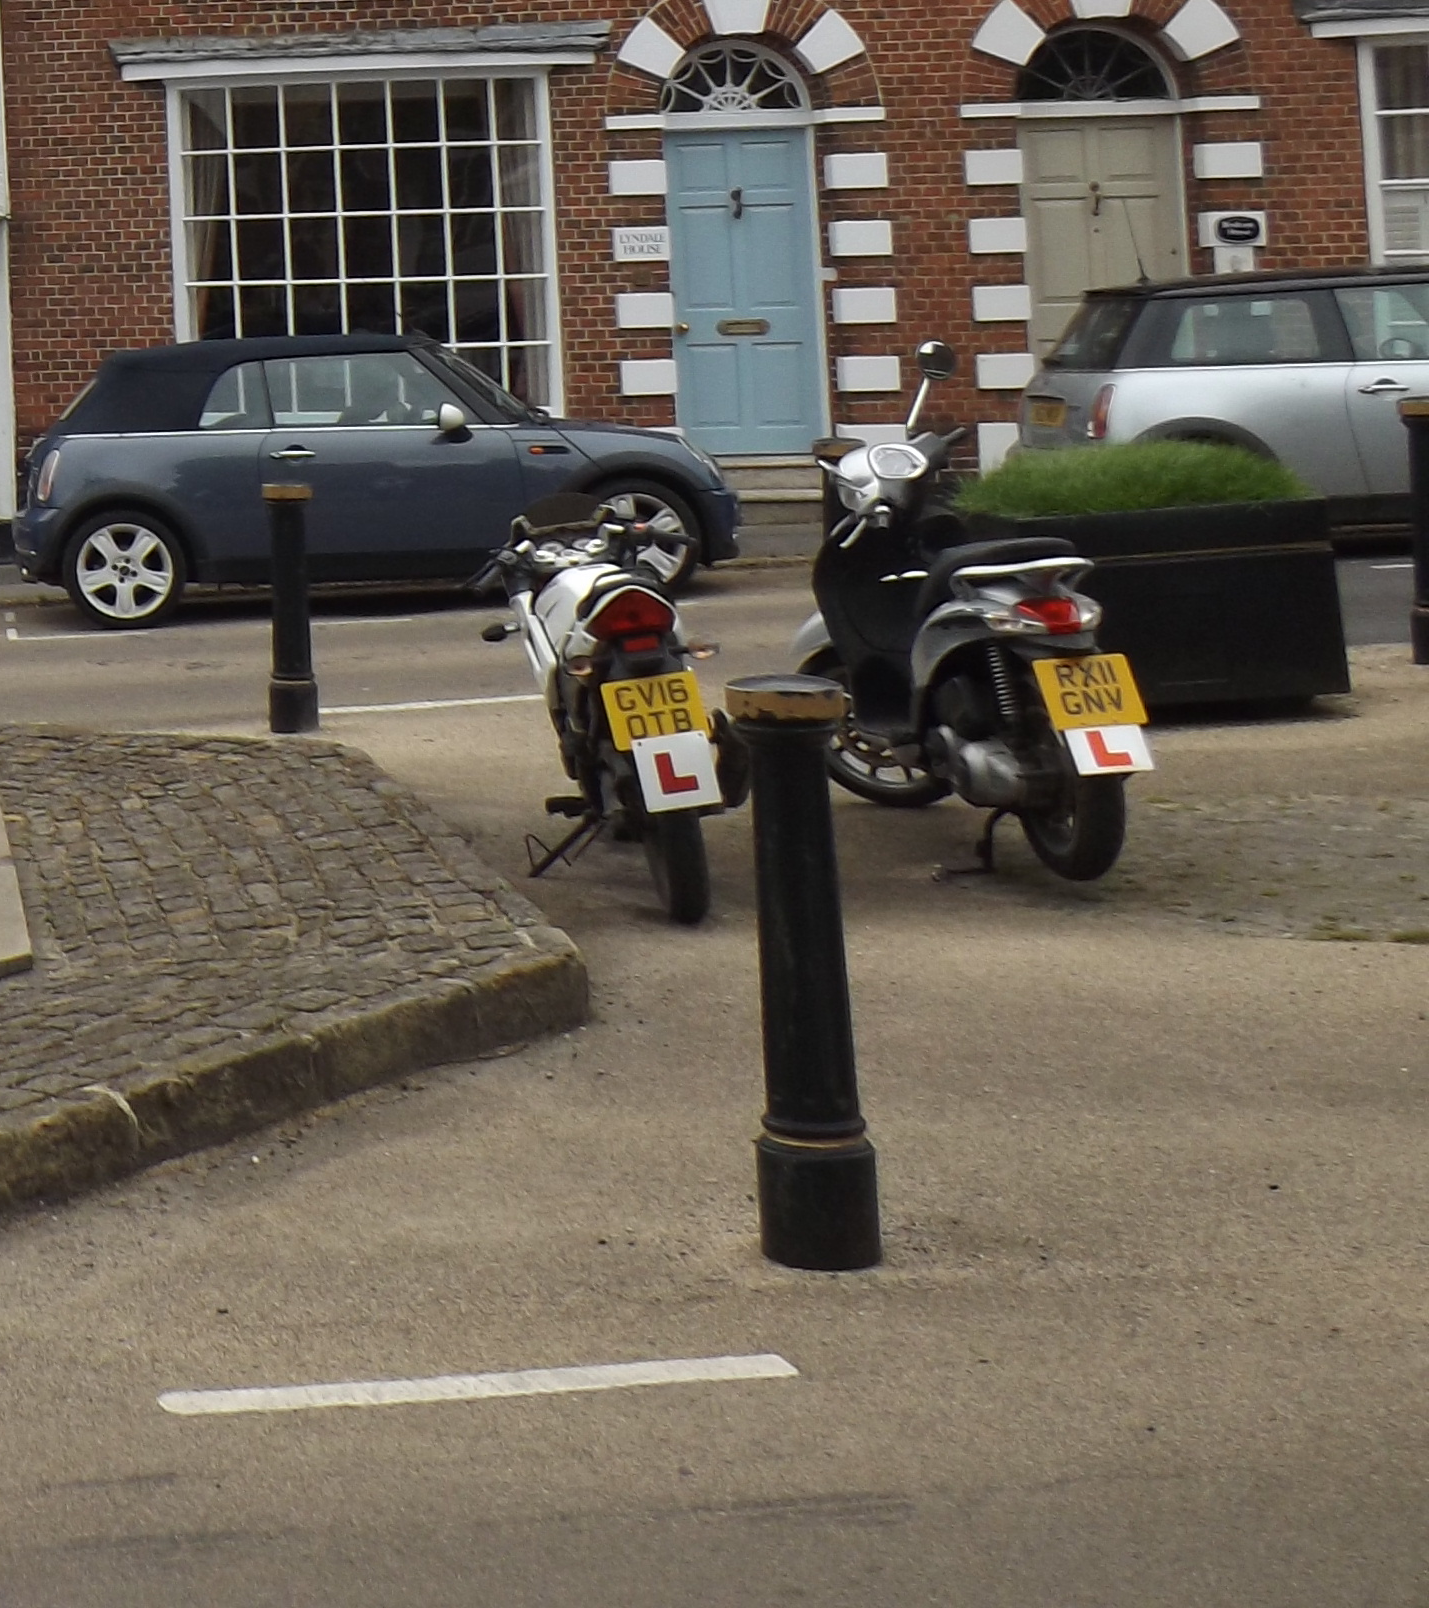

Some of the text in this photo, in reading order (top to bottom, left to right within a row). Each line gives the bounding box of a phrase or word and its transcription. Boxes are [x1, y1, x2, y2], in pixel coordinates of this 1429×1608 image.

[619, 233, 665, 244] LYNDALE
[623, 244, 662, 254] HOUSE
[1055, 659, 1118, 688] RX11
[614, 678, 689, 712] GV16
[1060, 687, 1124, 716] GNV
[1085, 730, 1134, 768] L
[653, 750, 701, 796] L
